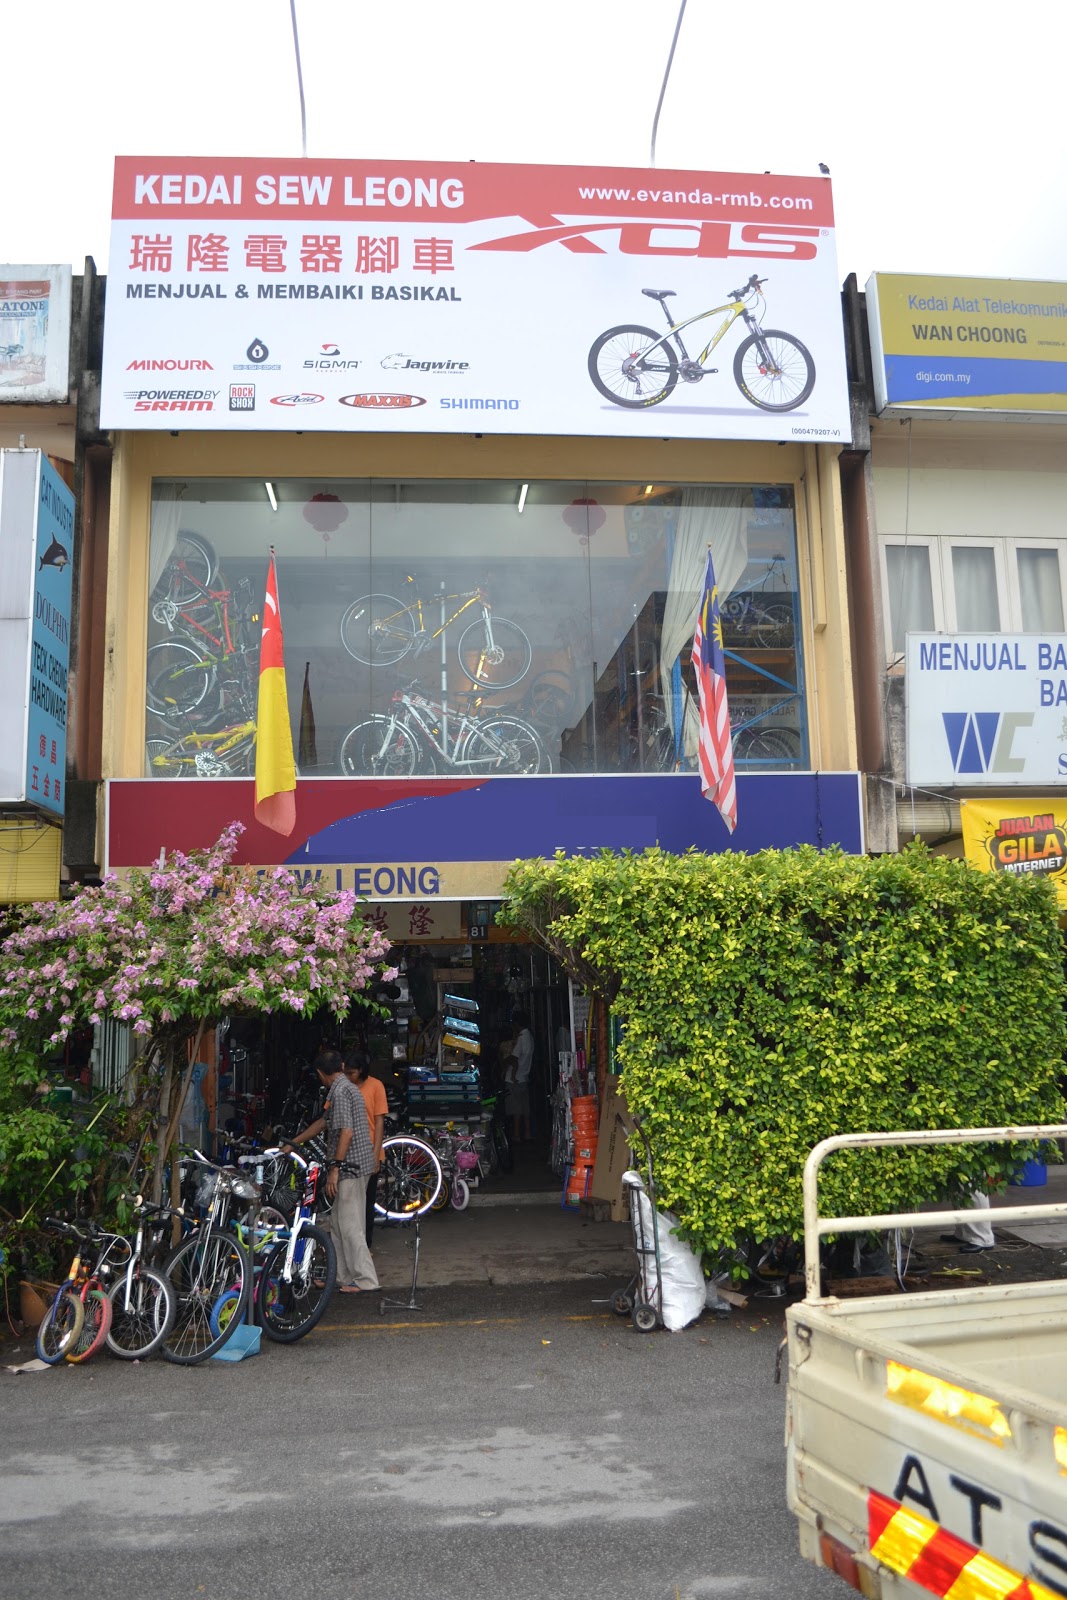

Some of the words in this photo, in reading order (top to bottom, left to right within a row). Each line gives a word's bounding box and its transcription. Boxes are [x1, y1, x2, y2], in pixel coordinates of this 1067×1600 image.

[135, 175, 242, 205] KEDAI
[255, 176, 332, 206] SEW
[344, 177, 465, 208] LEONG
[579, 186, 813, 210] www.evanda-rmb.com
[129, 233, 455, 275] 瑞隆電器腳車
[126, 284, 227, 299] MENJUAL
[234, 284, 249, 299] &
[257, 284, 363, 300] MEMBAIKI
[372, 285, 462, 302] BASIKAL
[0, 300, 45, 311] ATONE
[908, 295, 948, 311] Kedai
[952, 297, 980, 313] Alat
[912, 324, 953, 341] WAN
[957, 326, 1027, 344] CHOONG
[126, 360, 214, 371] MINOURA
[302, 360, 359, 369] SIGMA
[401, 359, 470, 372] Jagwire
[916, 371, 971, 384] digi.com.my
[138, 390, 204, 400] POWERED
[231, 387, 253, 397] ROCK
[353, 394, 413, 407] MAXXIS
[134, 401, 214, 411] SRAM
[231, 398, 253, 409] SHOX
[440, 398, 520, 410] SHIMANO
[36, 590, 70, 645] DOLPHIN
[33, 640, 48, 677] TECK
[920, 642, 1027, 671] MENJUAL
[1038, 643, 1067, 671] BA
[31, 675, 66, 726] HARDWARE
[996, 813, 1055, 838] JUALAN
[998, 833, 1063, 863] GILA
[1003, 856, 1063, 874] INTERNET
[470, 926, 485, 937] 81
